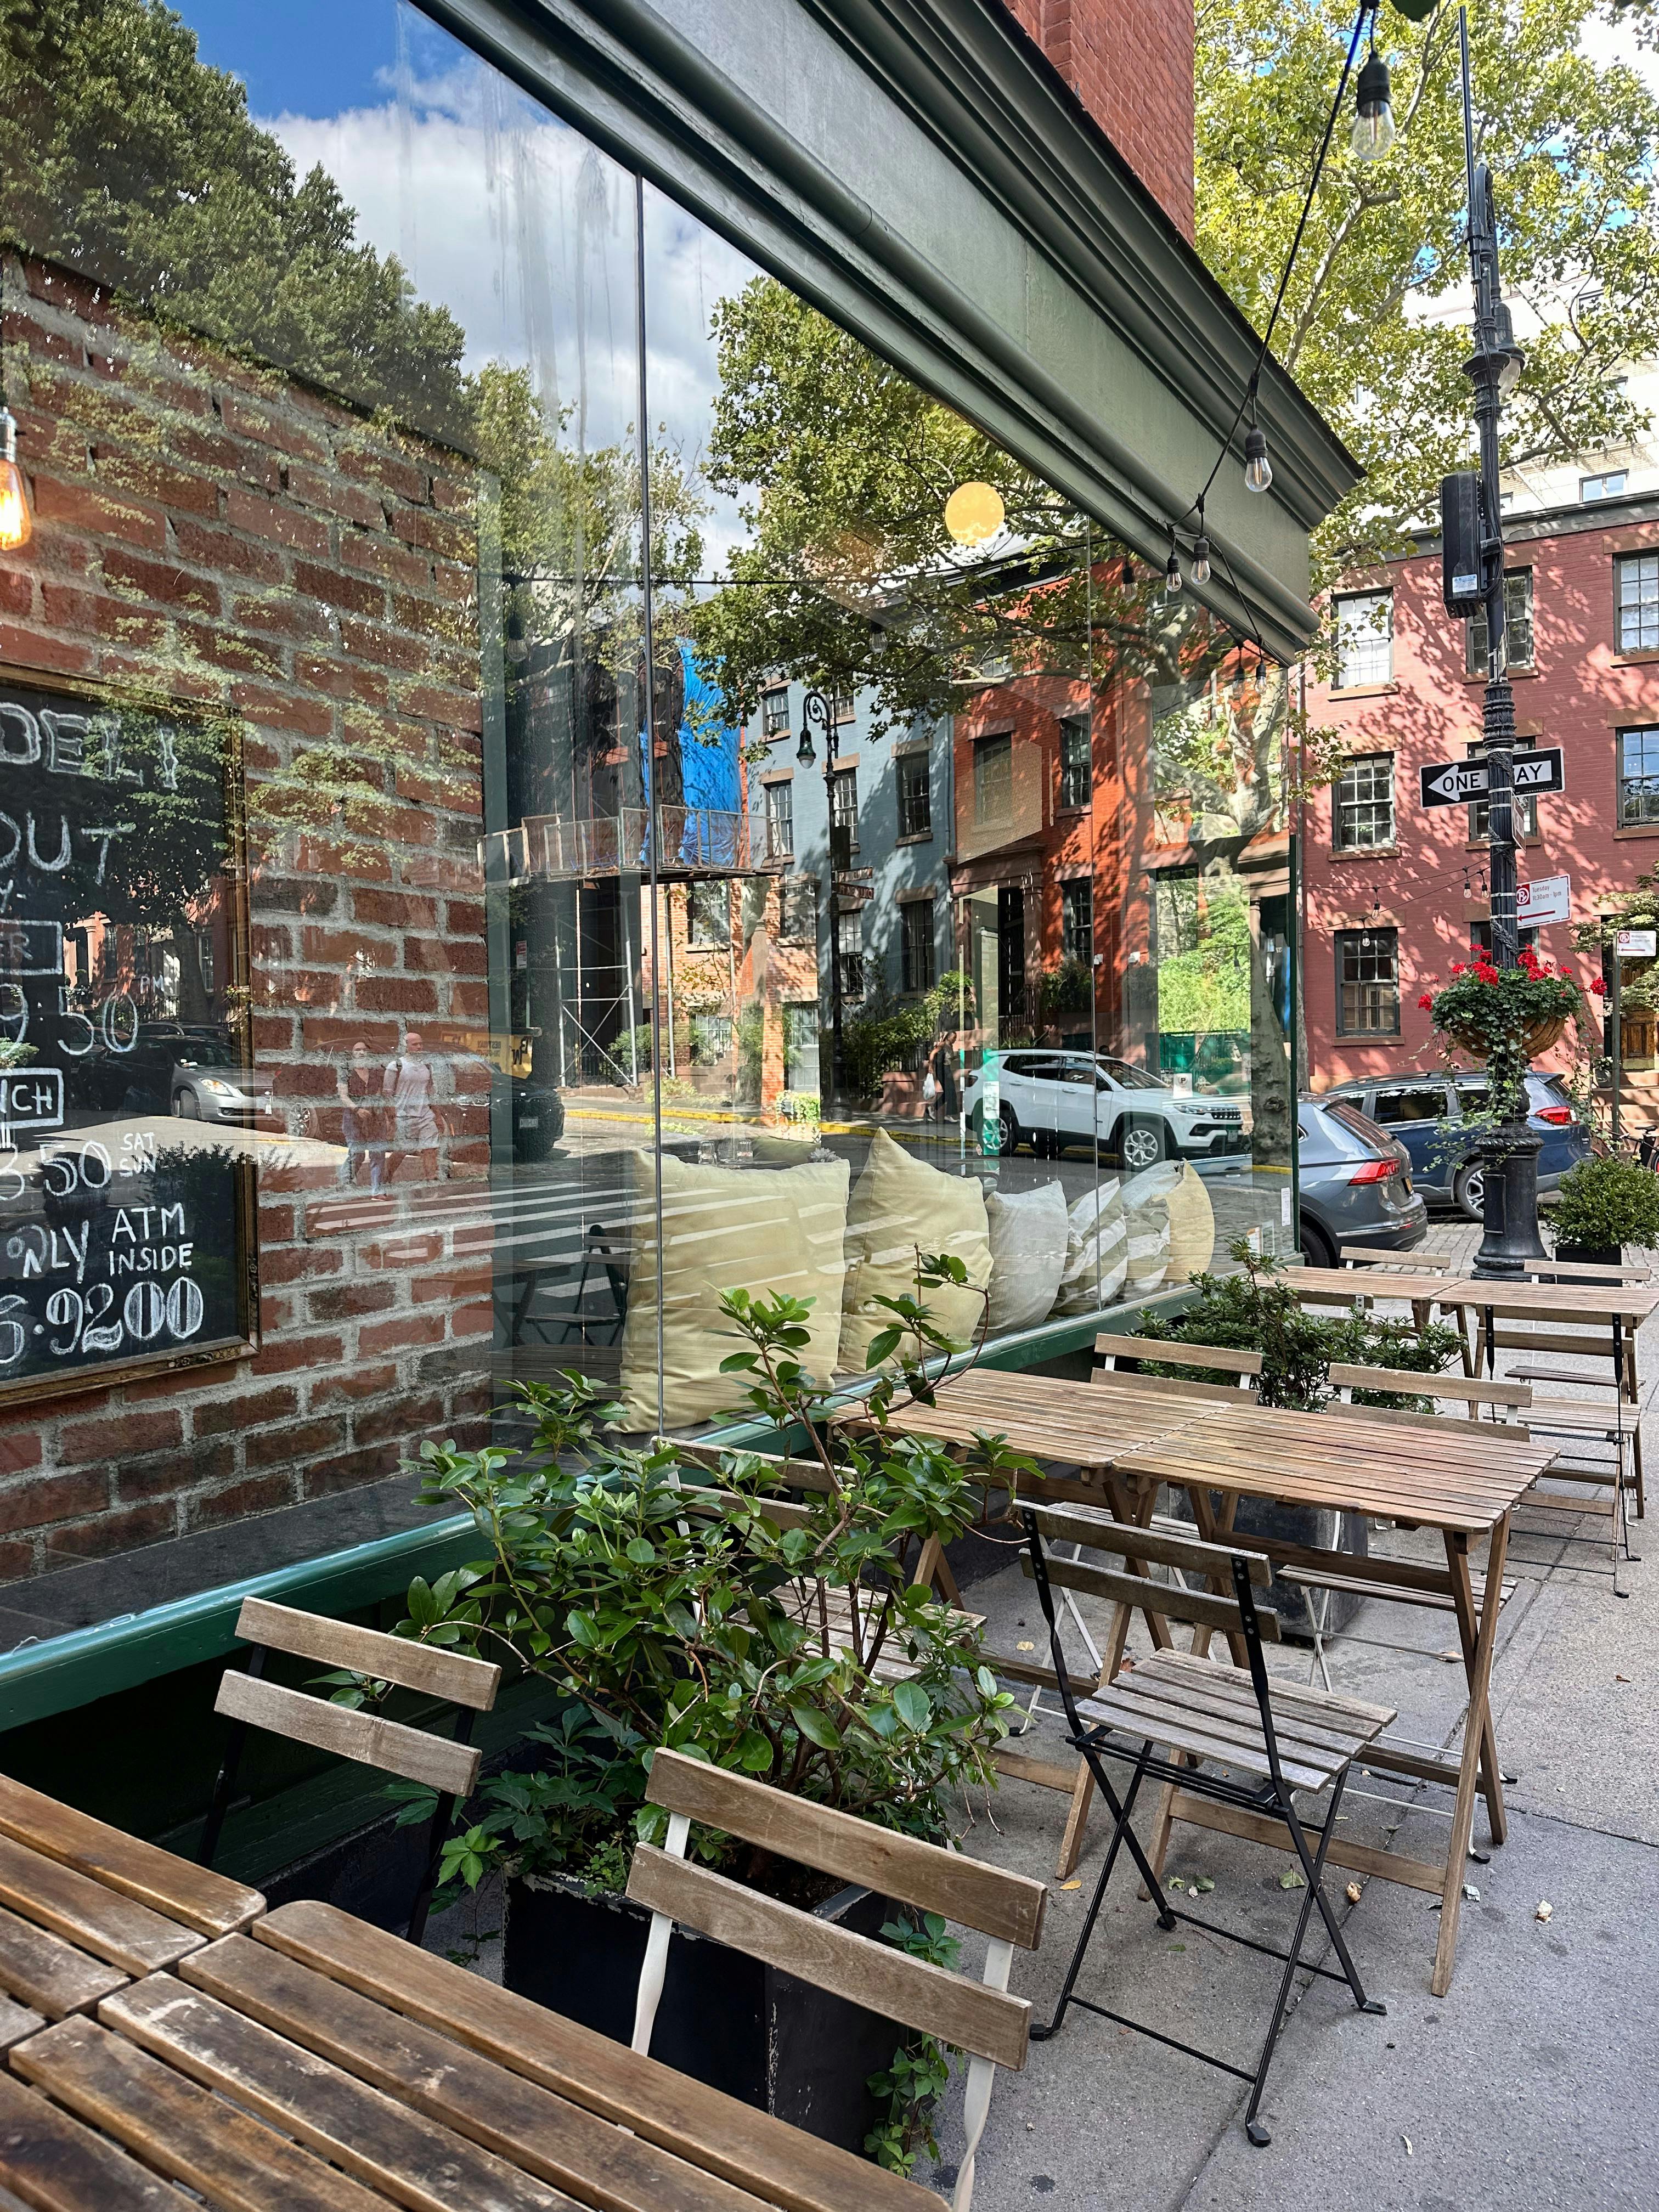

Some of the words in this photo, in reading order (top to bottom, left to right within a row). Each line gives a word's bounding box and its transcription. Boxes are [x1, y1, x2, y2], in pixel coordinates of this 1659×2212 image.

[1443, 772, 1481, 792] ONE
[1516, 764, 1543, 782] AY
[0, 1079, 53, 1115] CH
[120, 1132, 155, 1150] SAT
[119, 1154, 157, 1177] SUN
[112, 1202, 186, 1243] ATM
[109, 1242, 194, 1277] INSIDE
